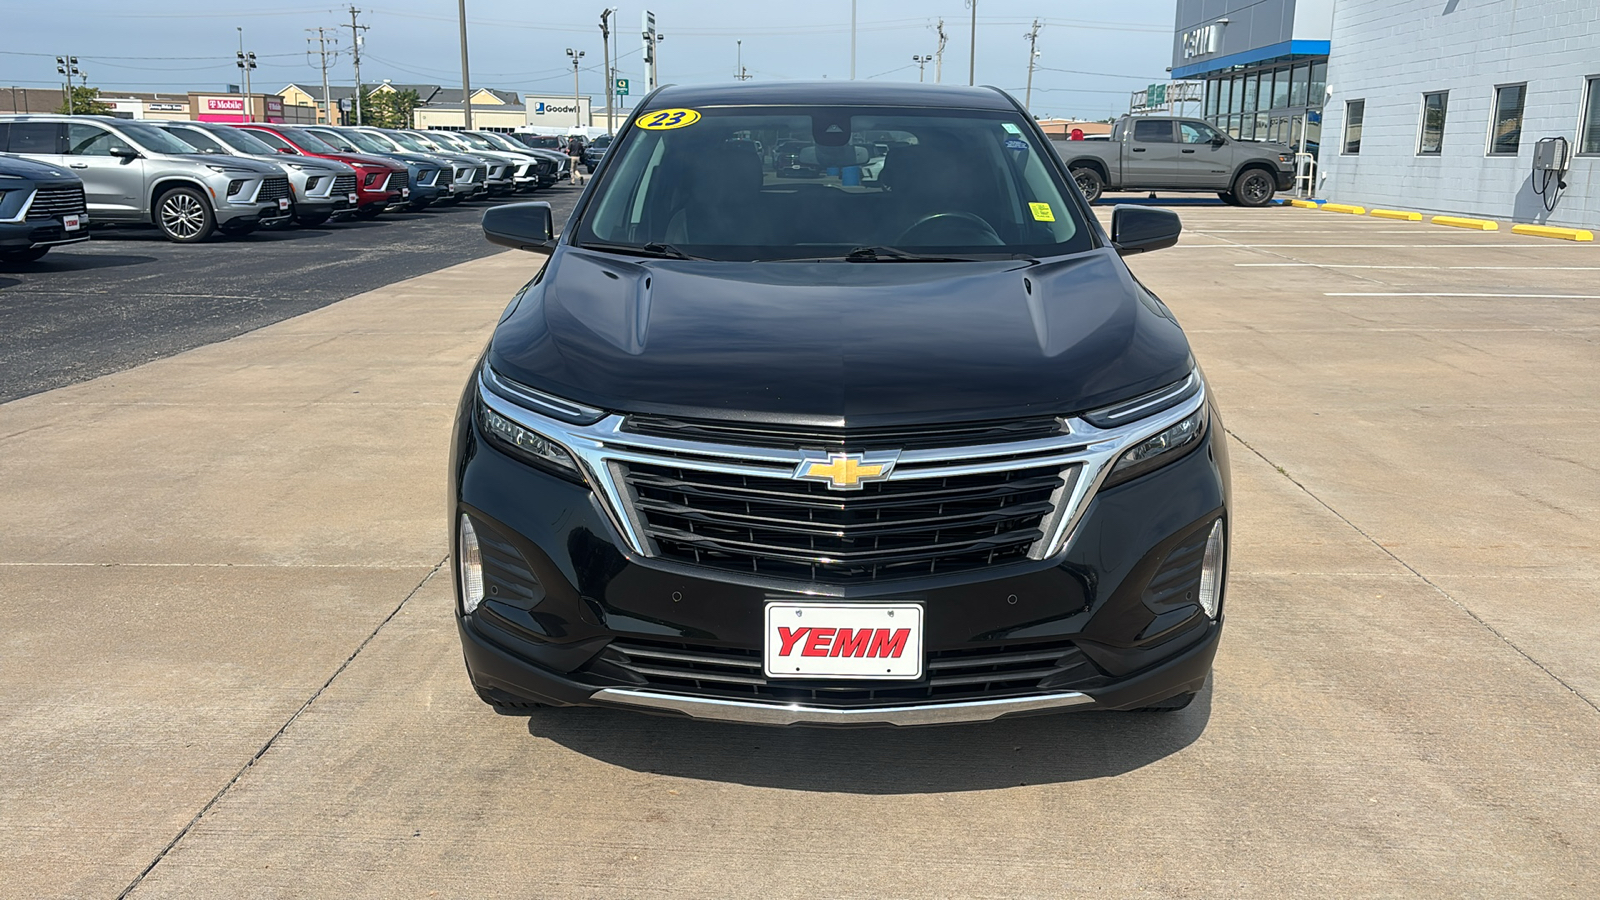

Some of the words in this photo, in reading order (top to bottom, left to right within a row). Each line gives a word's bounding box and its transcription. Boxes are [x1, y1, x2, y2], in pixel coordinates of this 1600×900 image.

[545, 105, 580, 113] Goodwil
[647, 111, 686, 127] 23
[777, 627, 911, 658] YEMM
